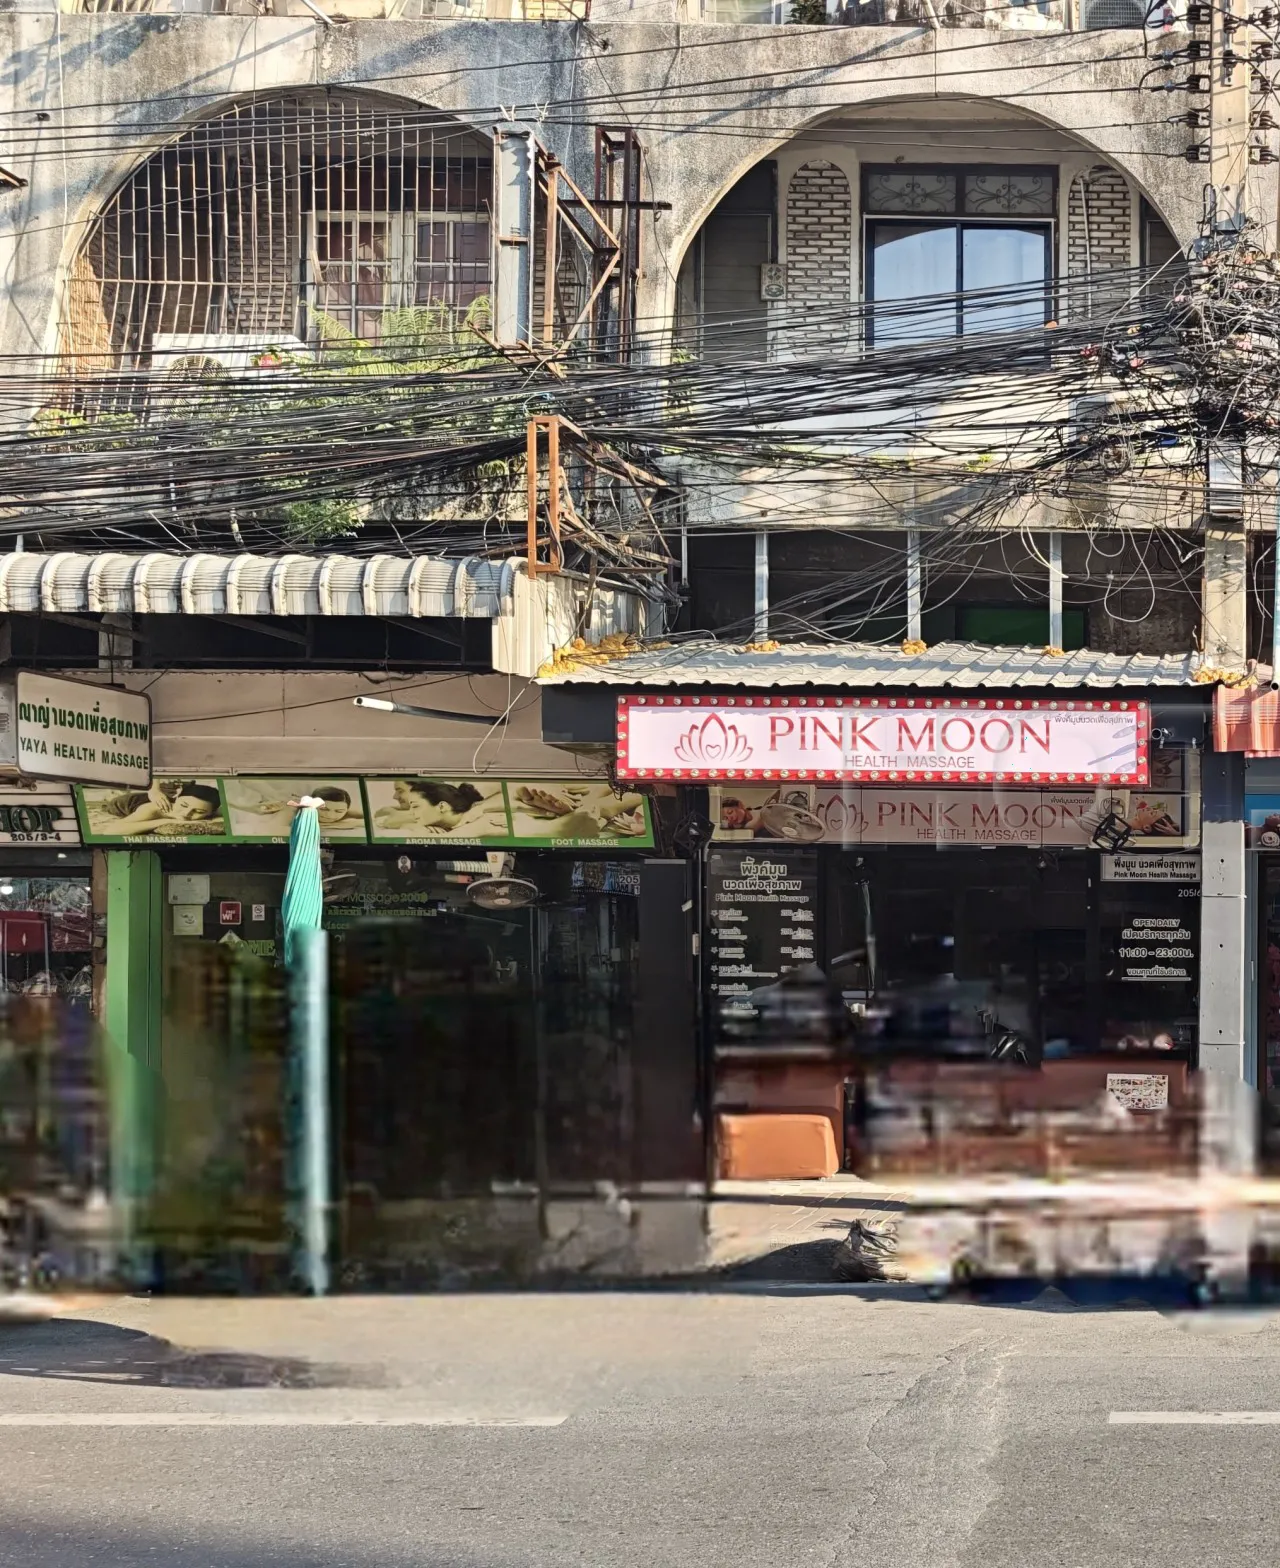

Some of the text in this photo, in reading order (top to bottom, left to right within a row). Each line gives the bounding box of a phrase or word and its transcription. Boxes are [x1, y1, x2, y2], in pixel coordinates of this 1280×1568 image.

[768, 716, 1052, 755] PINK MOON
[20, 737, 149, 770] YAYA HEALTH MASSAGE
[844, 755, 976, 769] HEALTH MASSAGE
[876, 800, 1084, 829] PINK MOON
[11, 832, 61, 842] 205/3-4
[917, 827, 1037, 841] HEALTH MASSAGE
[122, 836, 188, 844] THAI MASSAGE
[271, 836, 286, 844] OIL
[405, 838, 482, 846] AROMA MASSAGE
[551, 838, 619, 847] FOOT MASSAGE
[1139, 857, 1196, 872] นวดเพื่อสุขภาพ
[620, 875, 639, 884] 205
[1114, 871, 1197, 880] Pink Moon Health Massage
[1133, 919, 1180, 928] OPEN DAILY
[1122, 928, 1191, 943] เปิดบริการทุกวัน
[1119, 948, 1148, 958] 11:00
